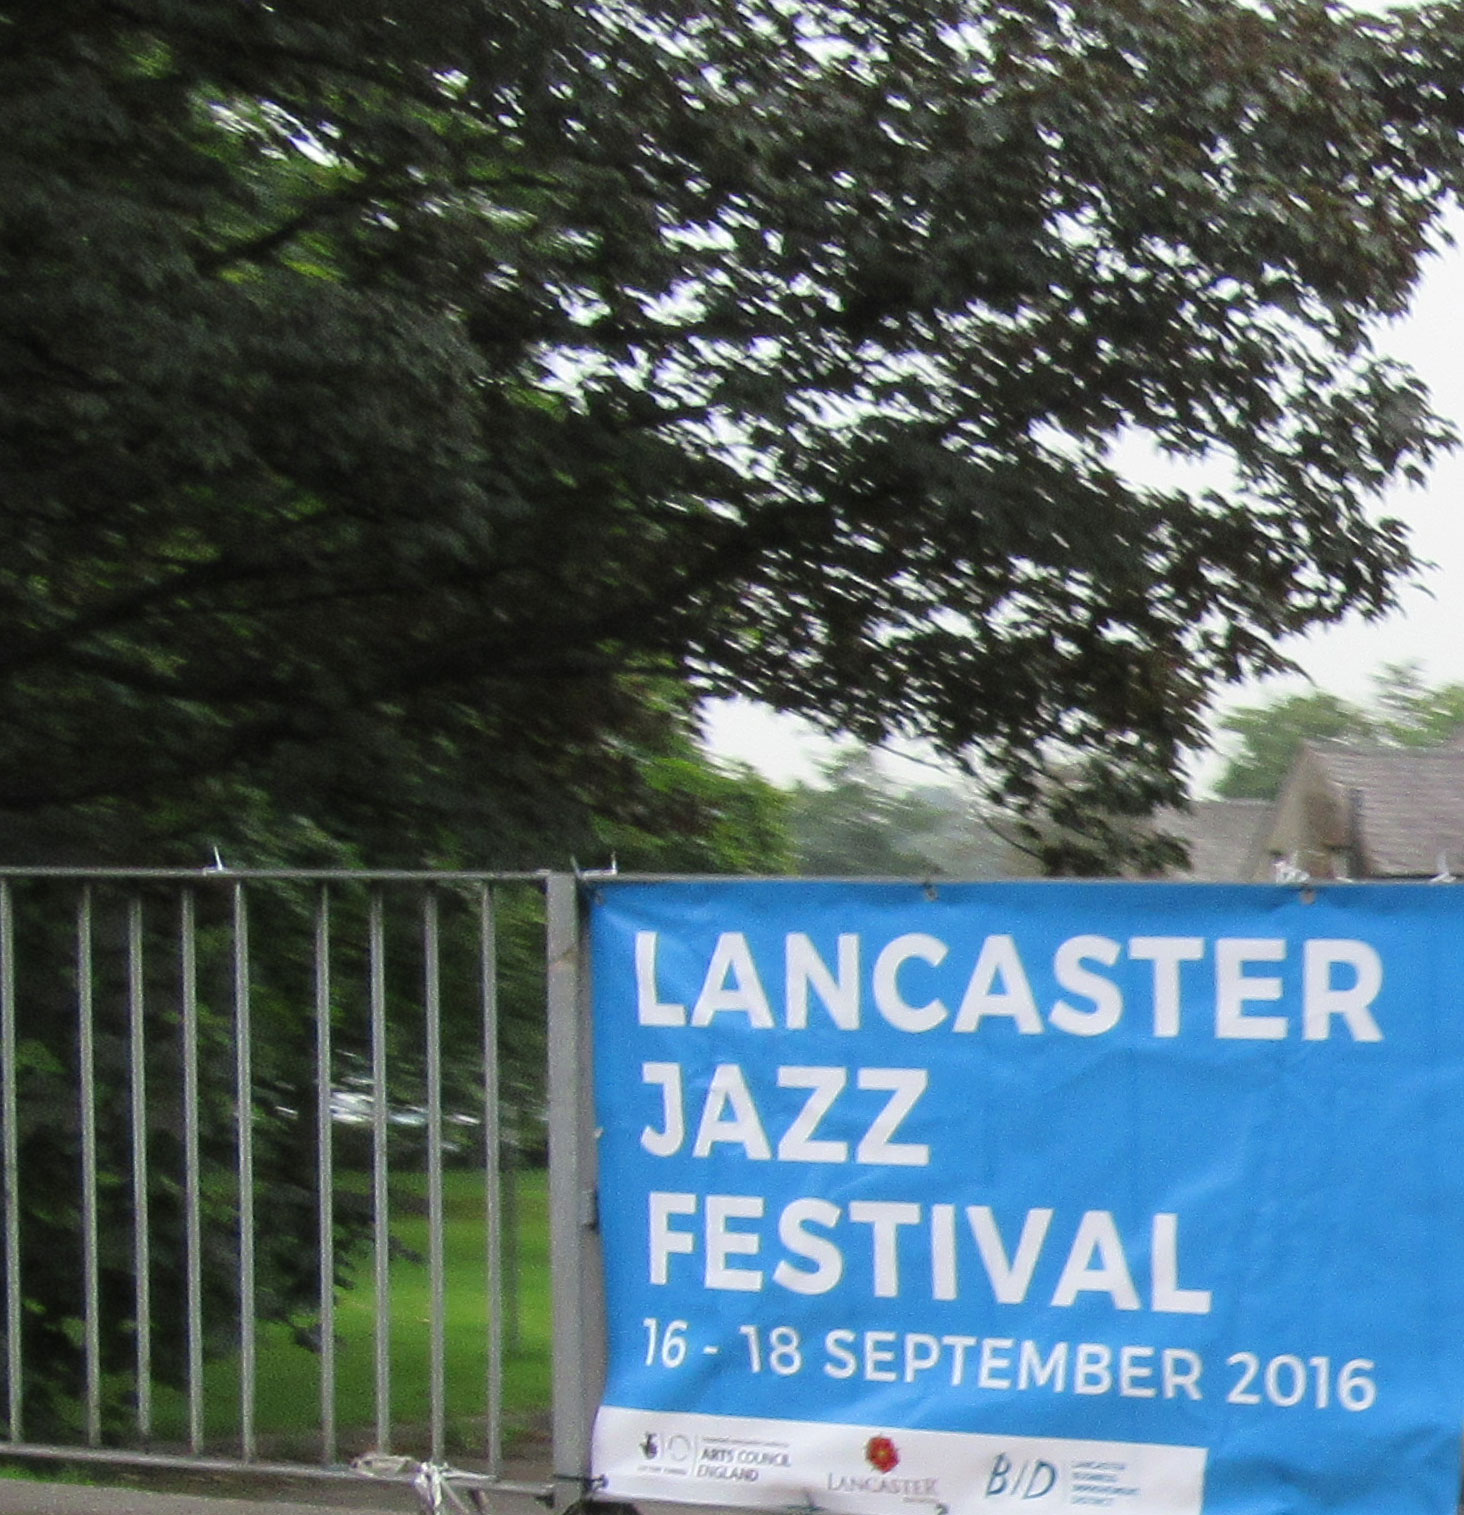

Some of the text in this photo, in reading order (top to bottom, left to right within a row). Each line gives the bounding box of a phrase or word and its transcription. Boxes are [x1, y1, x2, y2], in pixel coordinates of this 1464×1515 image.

[635, 931, 1382, 1041] LANCASTER
[641, 1062, 929, 1166] JAZZ
[650, 1192, 1211, 1314] FESTIVAL
[644, 1318, 687, 1368] 16
[740, 1326, 801, 1375] 18
[825, 1330, 1201, 1399] SEPTEMBER
[1228, 1352, 1375, 1411] 2016
[697, 1464, 759, 1482] ENGLAND
[701, 1448, 791, 1467] ARTS COUNCIL
[827, 1472, 939, 1494] LANCASTER
